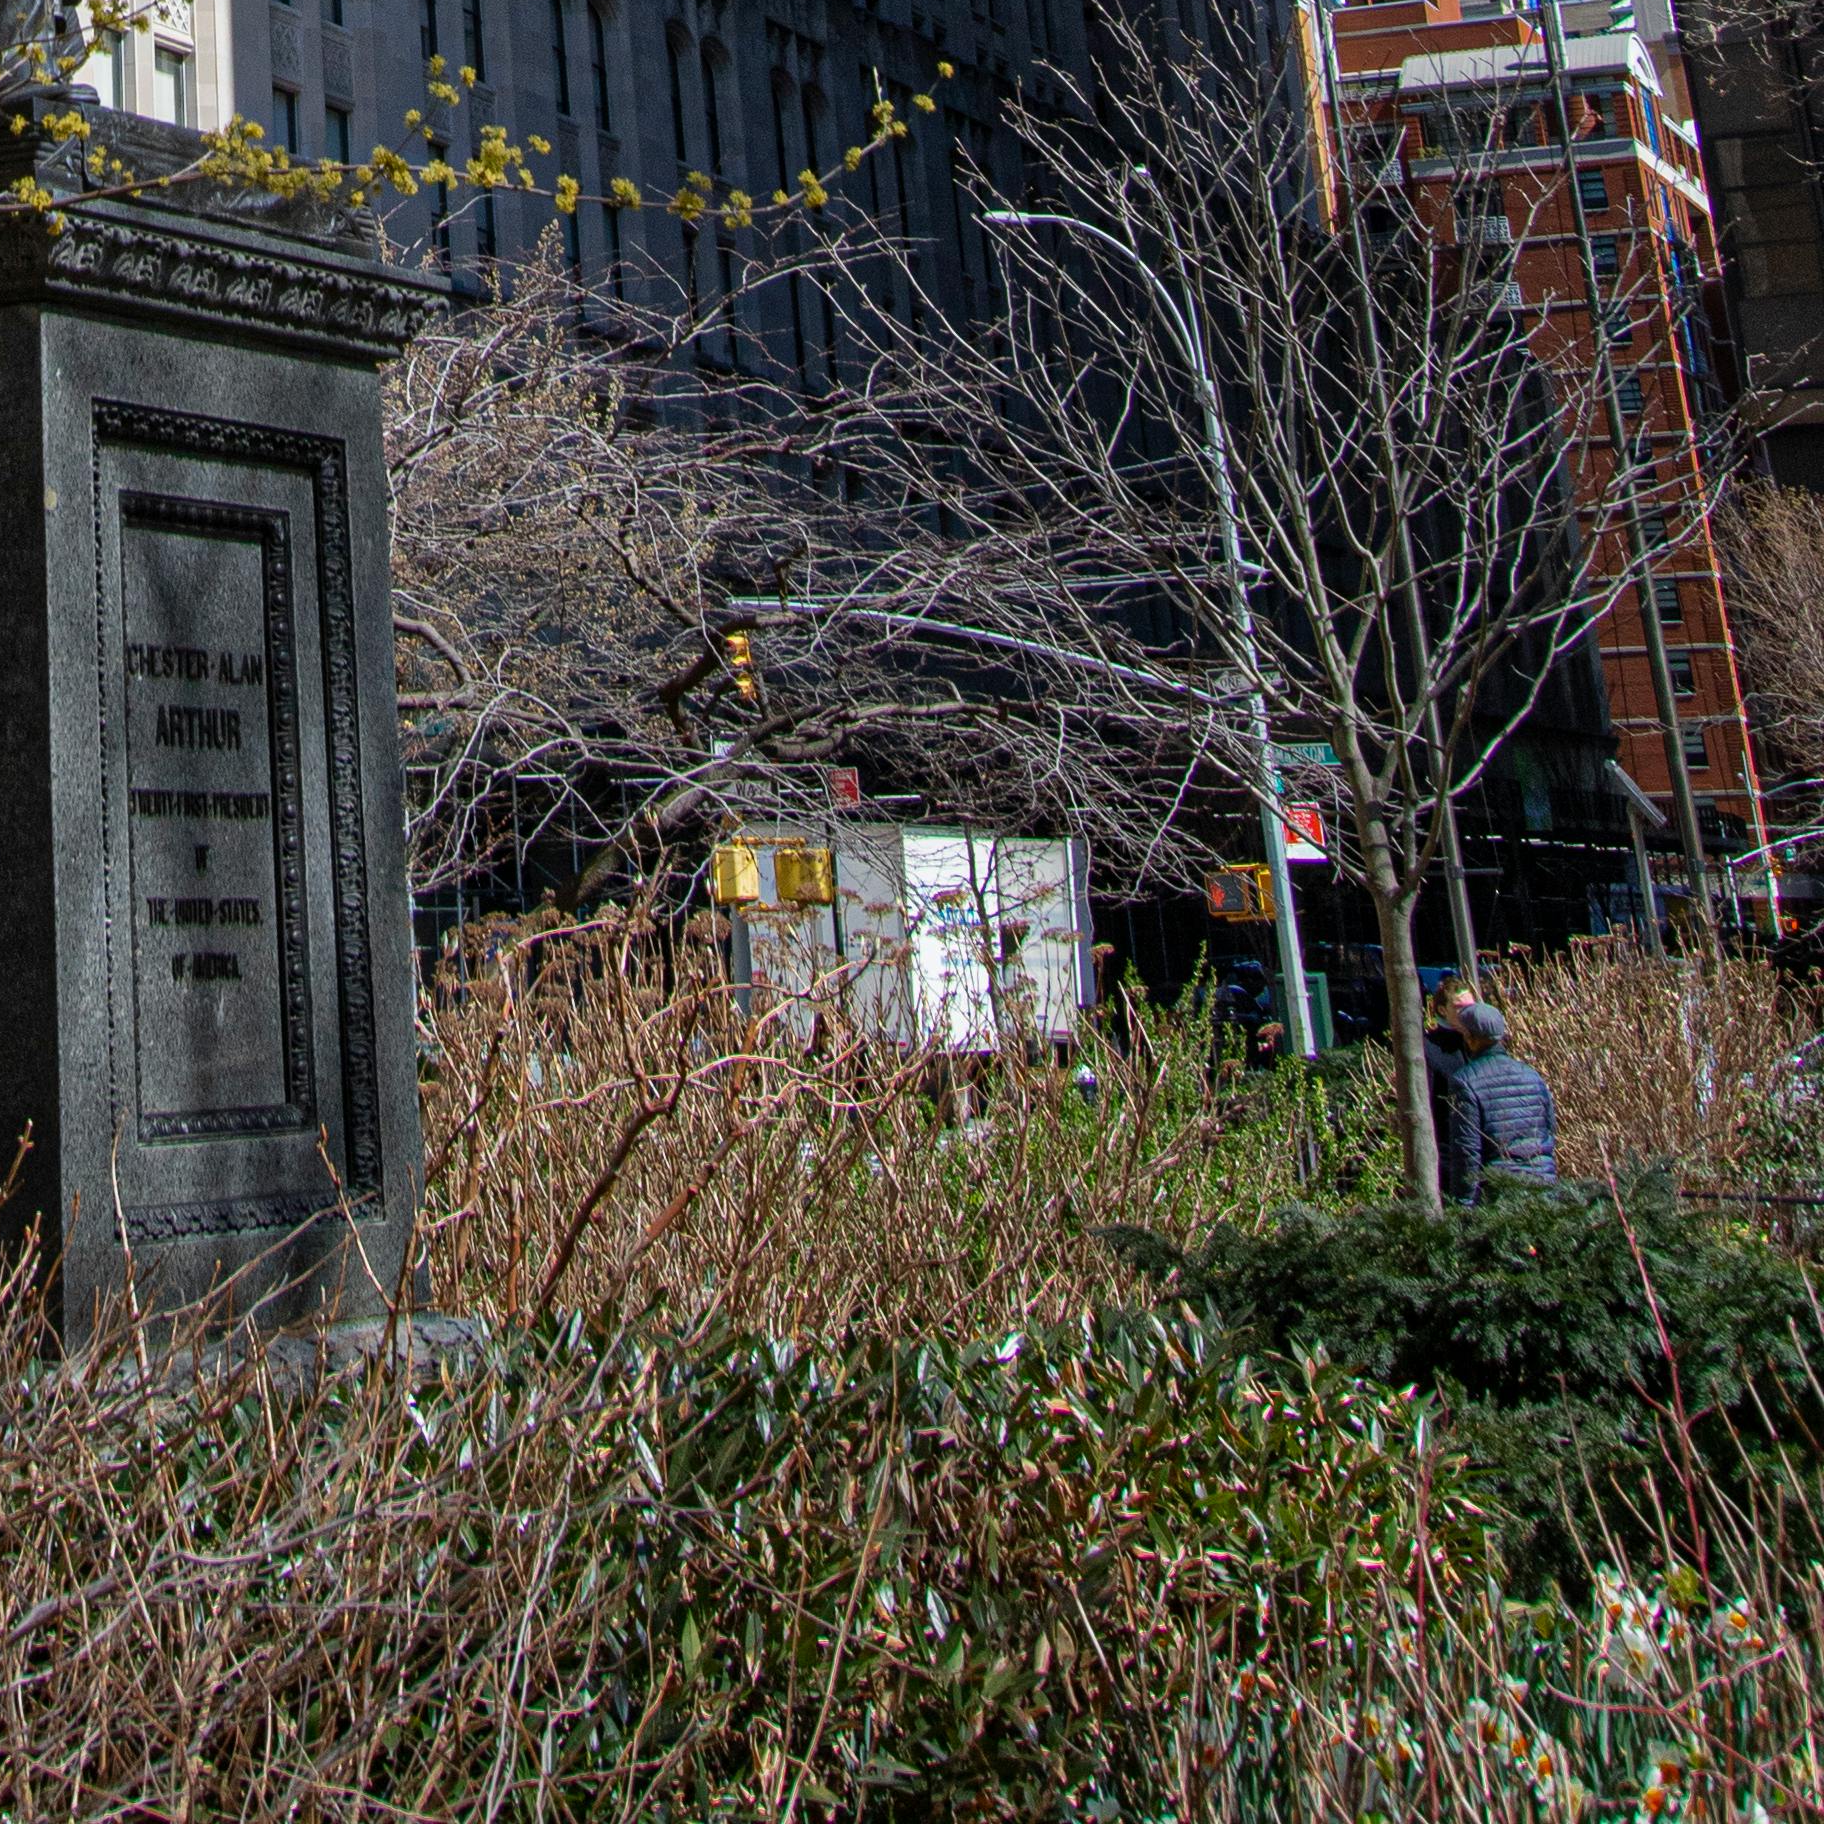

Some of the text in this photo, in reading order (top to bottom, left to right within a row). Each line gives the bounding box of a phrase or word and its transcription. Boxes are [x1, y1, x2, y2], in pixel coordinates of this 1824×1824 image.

[128, 643, 263, 686] CHESTER ALAN
[156, 704, 241, 751] ARTHUR
